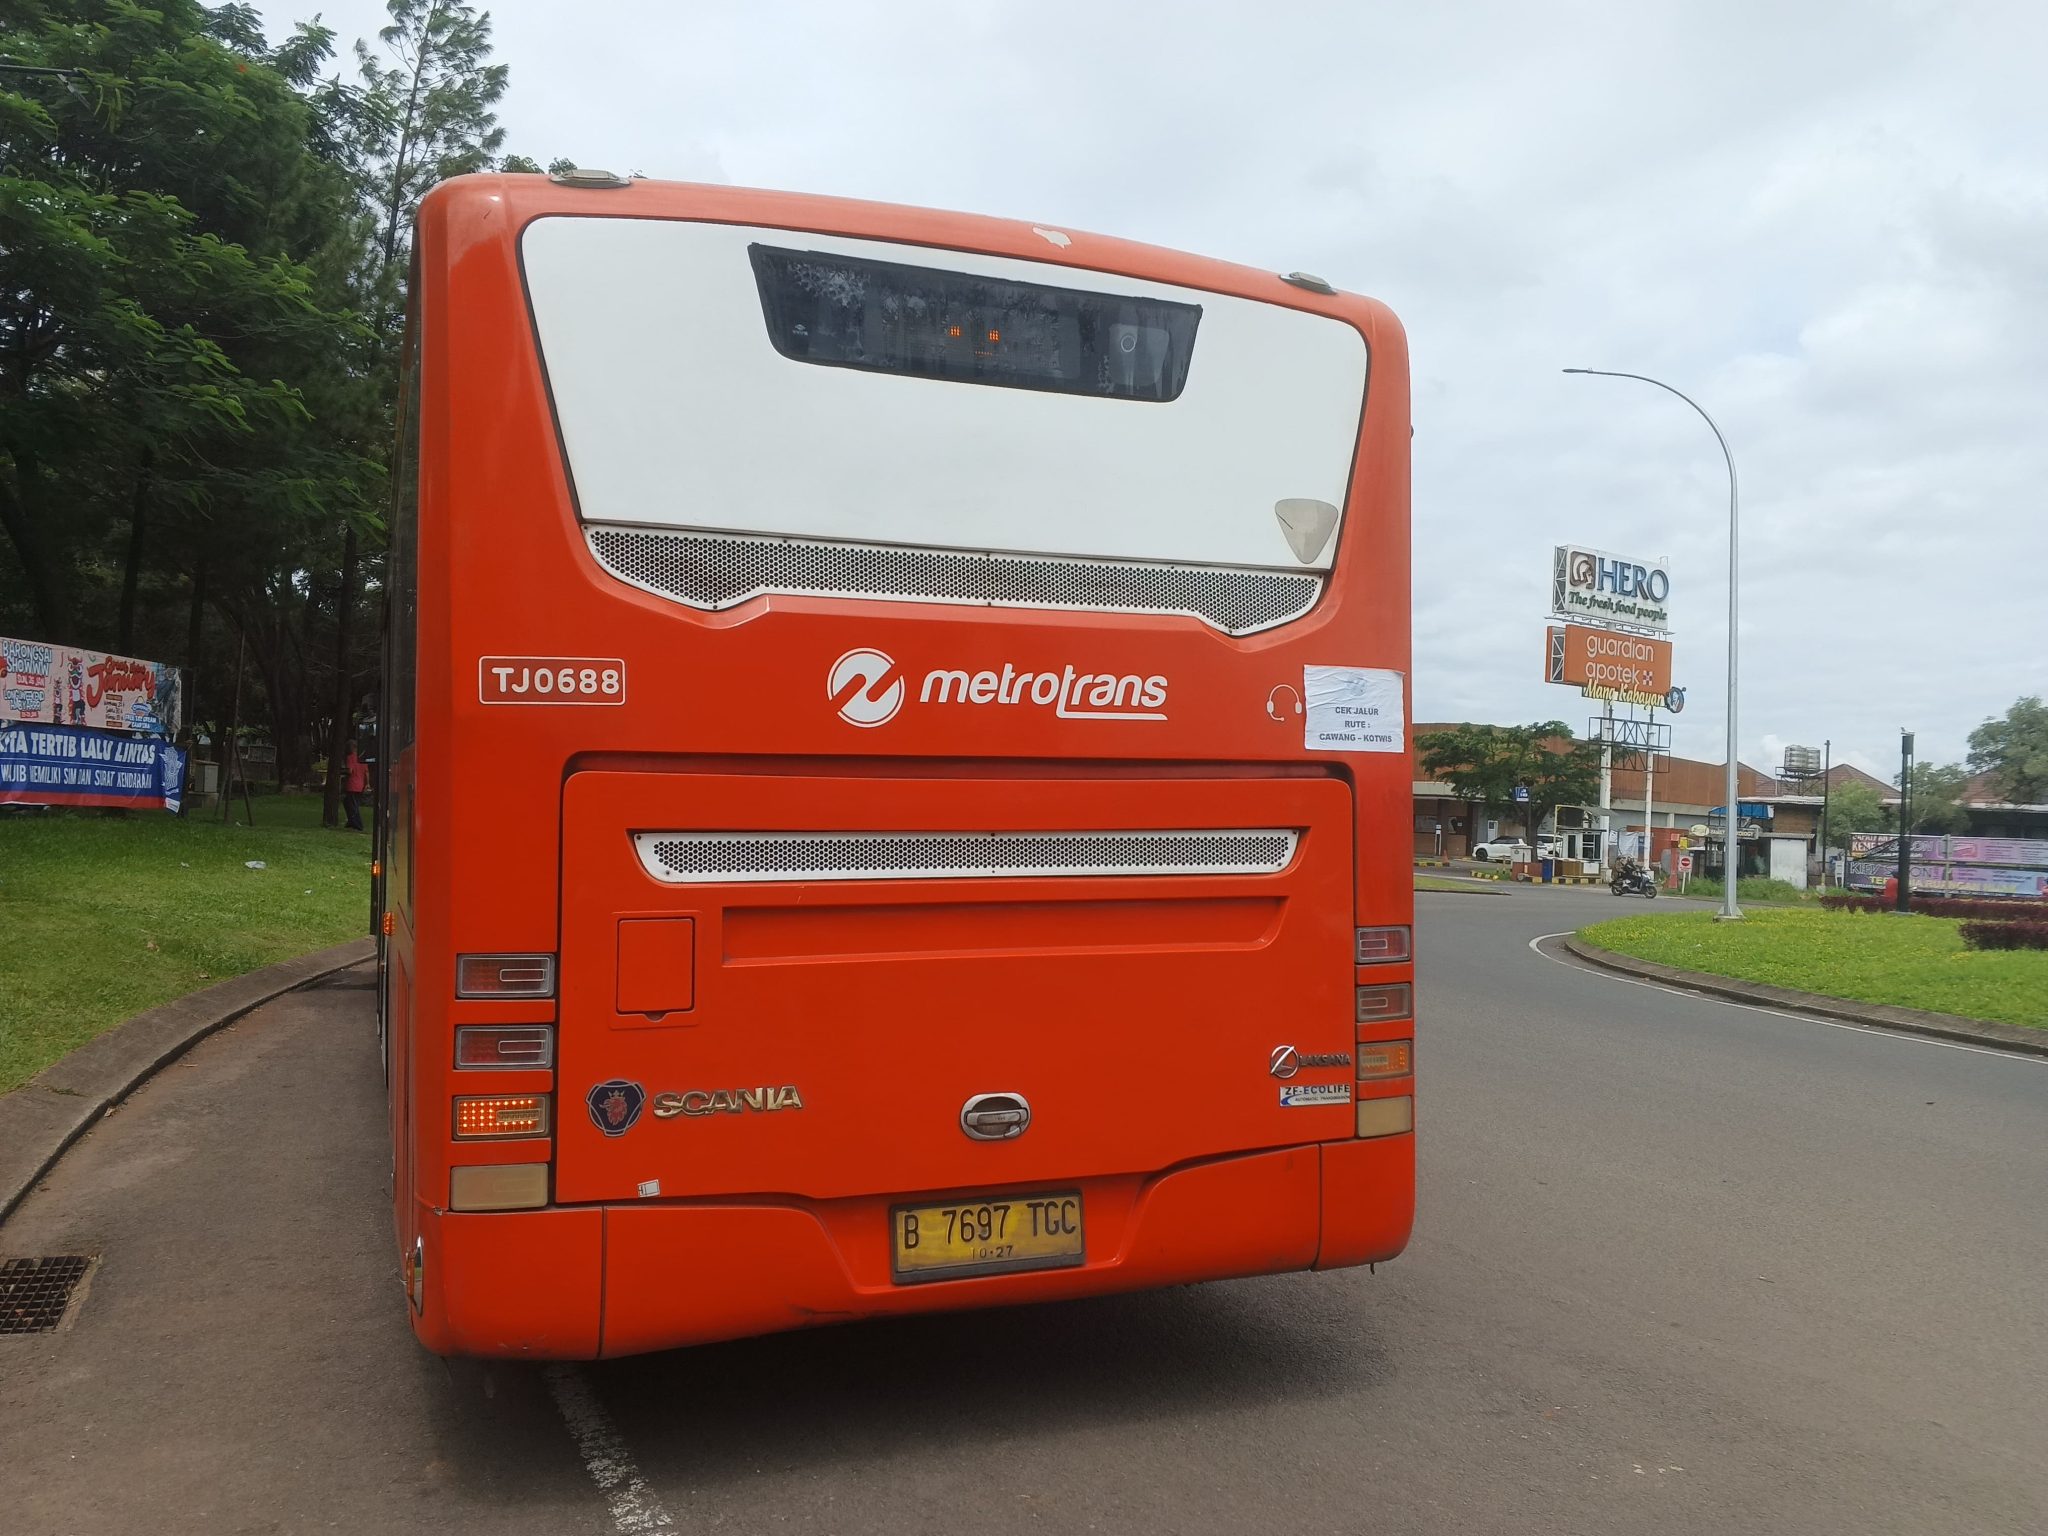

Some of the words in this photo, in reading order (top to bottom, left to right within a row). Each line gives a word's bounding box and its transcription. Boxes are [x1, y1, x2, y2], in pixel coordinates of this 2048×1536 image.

[1597, 557, 1669, 602] HERO
[1569, 591, 1588, 606] The
[1587, 595, 1614, 610] fresh
[1612, 599, 1637, 614] food
[1637, 602, 1668, 621] people
[3, 640, 52, 662] BARONGSAI
[1586, 635, 1654, 662] guardian
[491, 667, 620, 695] TJ0688
[1585, 661, 1640, 685] apotek
[919, 663, 1169, 721] metrotrans
[1584, 678, 1617, 706] Mang
[1619, 683, 1666, 710] Kabayan
[1335, 706, 1352, 715] CEK
[1353, 707, 1379, 716] JALUR
[1344, 720, 1366, 729] RUTE
[31, 732, 77, 758] TERTIB
[80, 736, 113, 761] LALU
[114, 741, 156, 765] LINTAS
[1319, 733, 1356, 742] CAWANG
[1363, 734, 1393, 743] KOTWIS
[653, 1086, 803, 1118] SCANIA
[1284, 1084, 1350, 1096] ZF-ECOLIFE
[904, 1214, 920, 1250] B
[941, 1205, 1011, 1245] 7697
[1025, 1199, 1076, 1237] TGC
